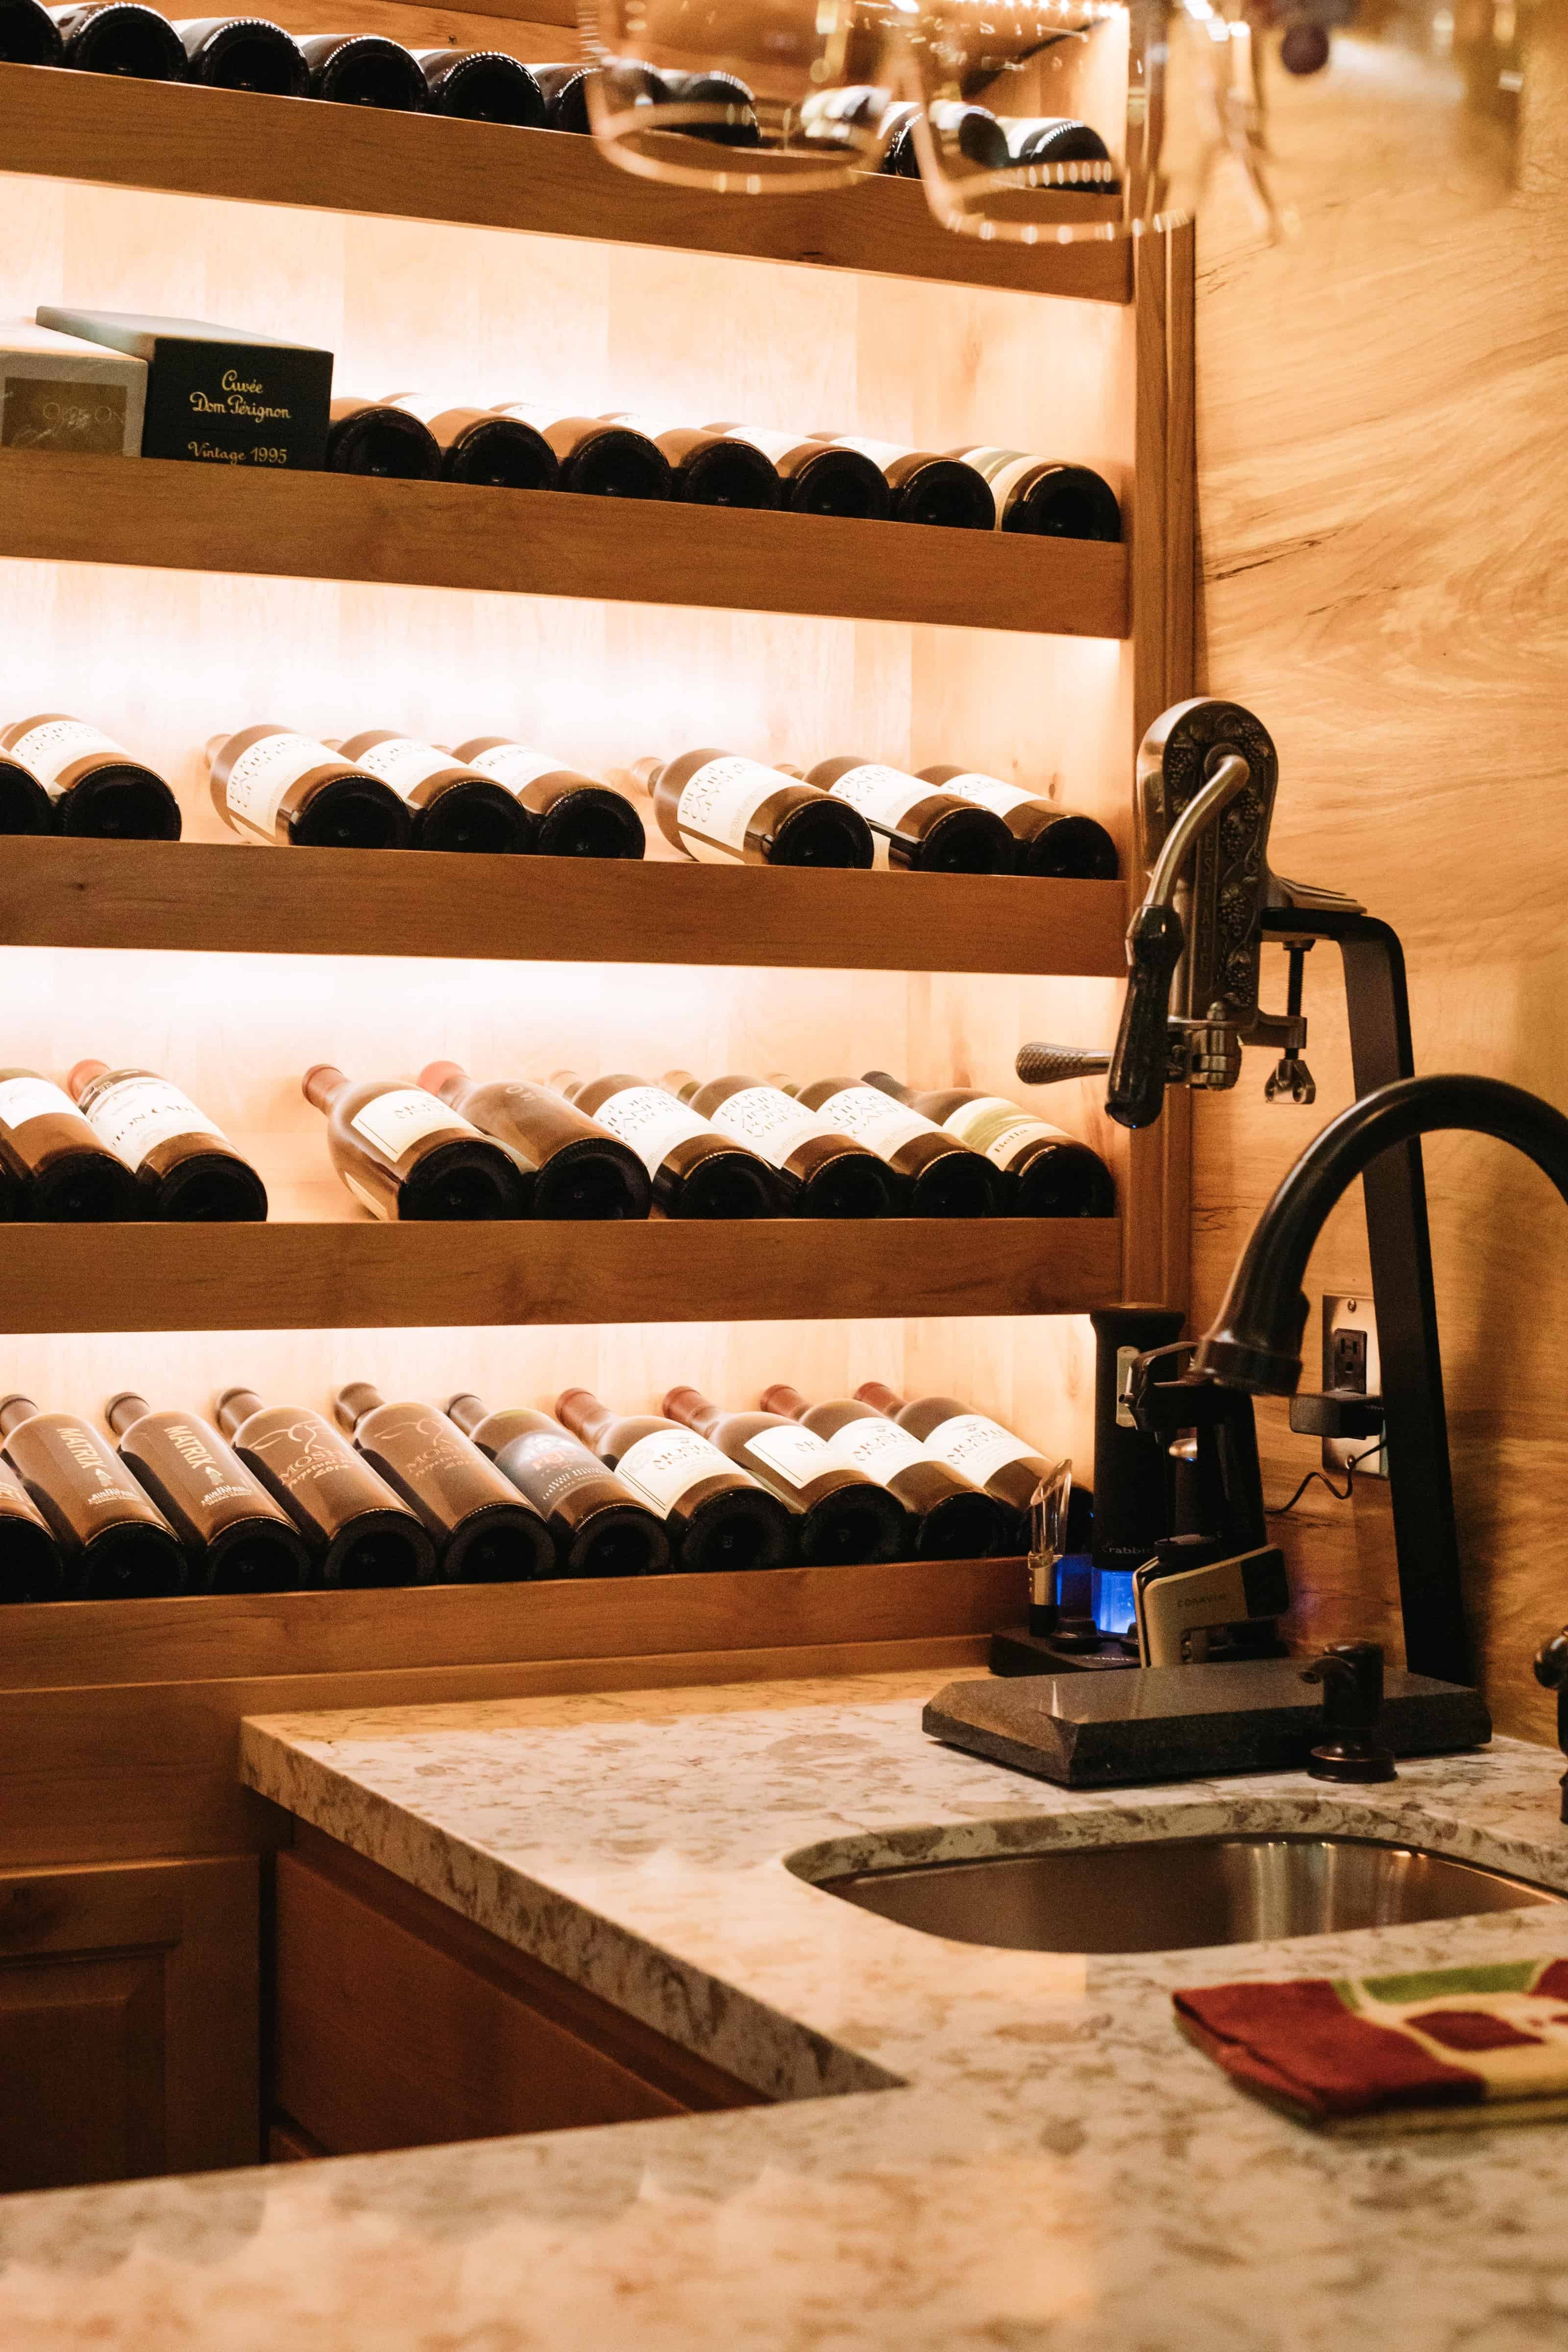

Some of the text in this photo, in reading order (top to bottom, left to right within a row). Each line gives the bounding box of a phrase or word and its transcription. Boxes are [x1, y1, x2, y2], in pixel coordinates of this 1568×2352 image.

[222, 369, 263, 393] Cuvée
[190, 392, 291, 423] Dom Pérignon
[188, 441, 288, 465] Vintage 1995
[55, 1428, 107, 1469] MATRIX
[163, 1425, 217, 1470] MATRIX
